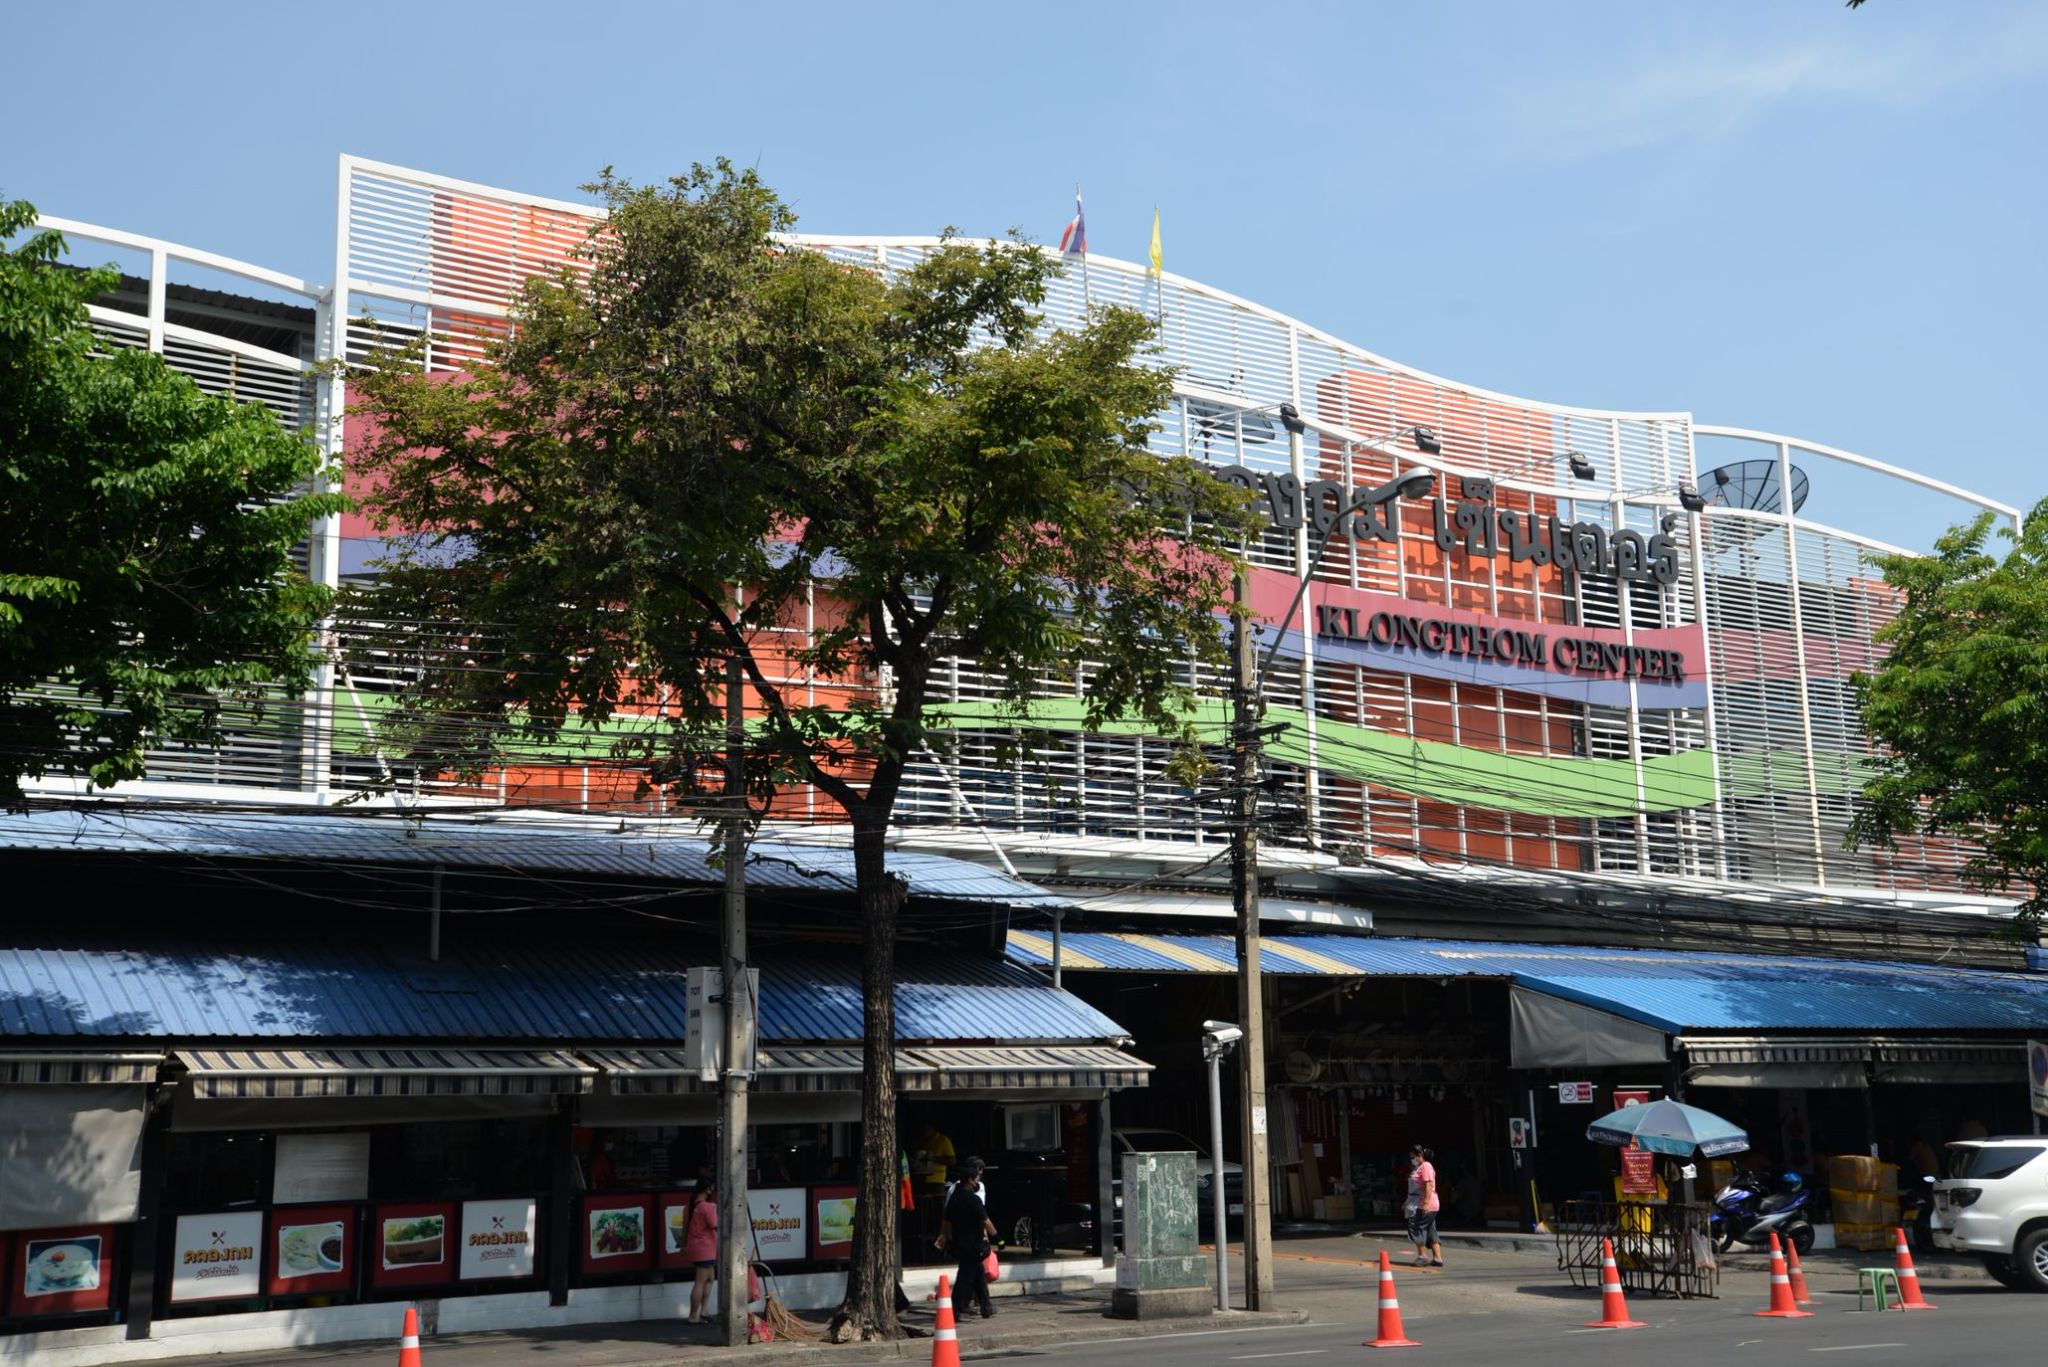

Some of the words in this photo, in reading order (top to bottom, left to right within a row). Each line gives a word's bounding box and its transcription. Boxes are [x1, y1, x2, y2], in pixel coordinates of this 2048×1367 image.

[1433, 478, 1679, 585] เซ็นเตอร์
[1317, 604, 1548, 666] KLONGTHOM
[1552, 636, 1685, 680] CENTER
